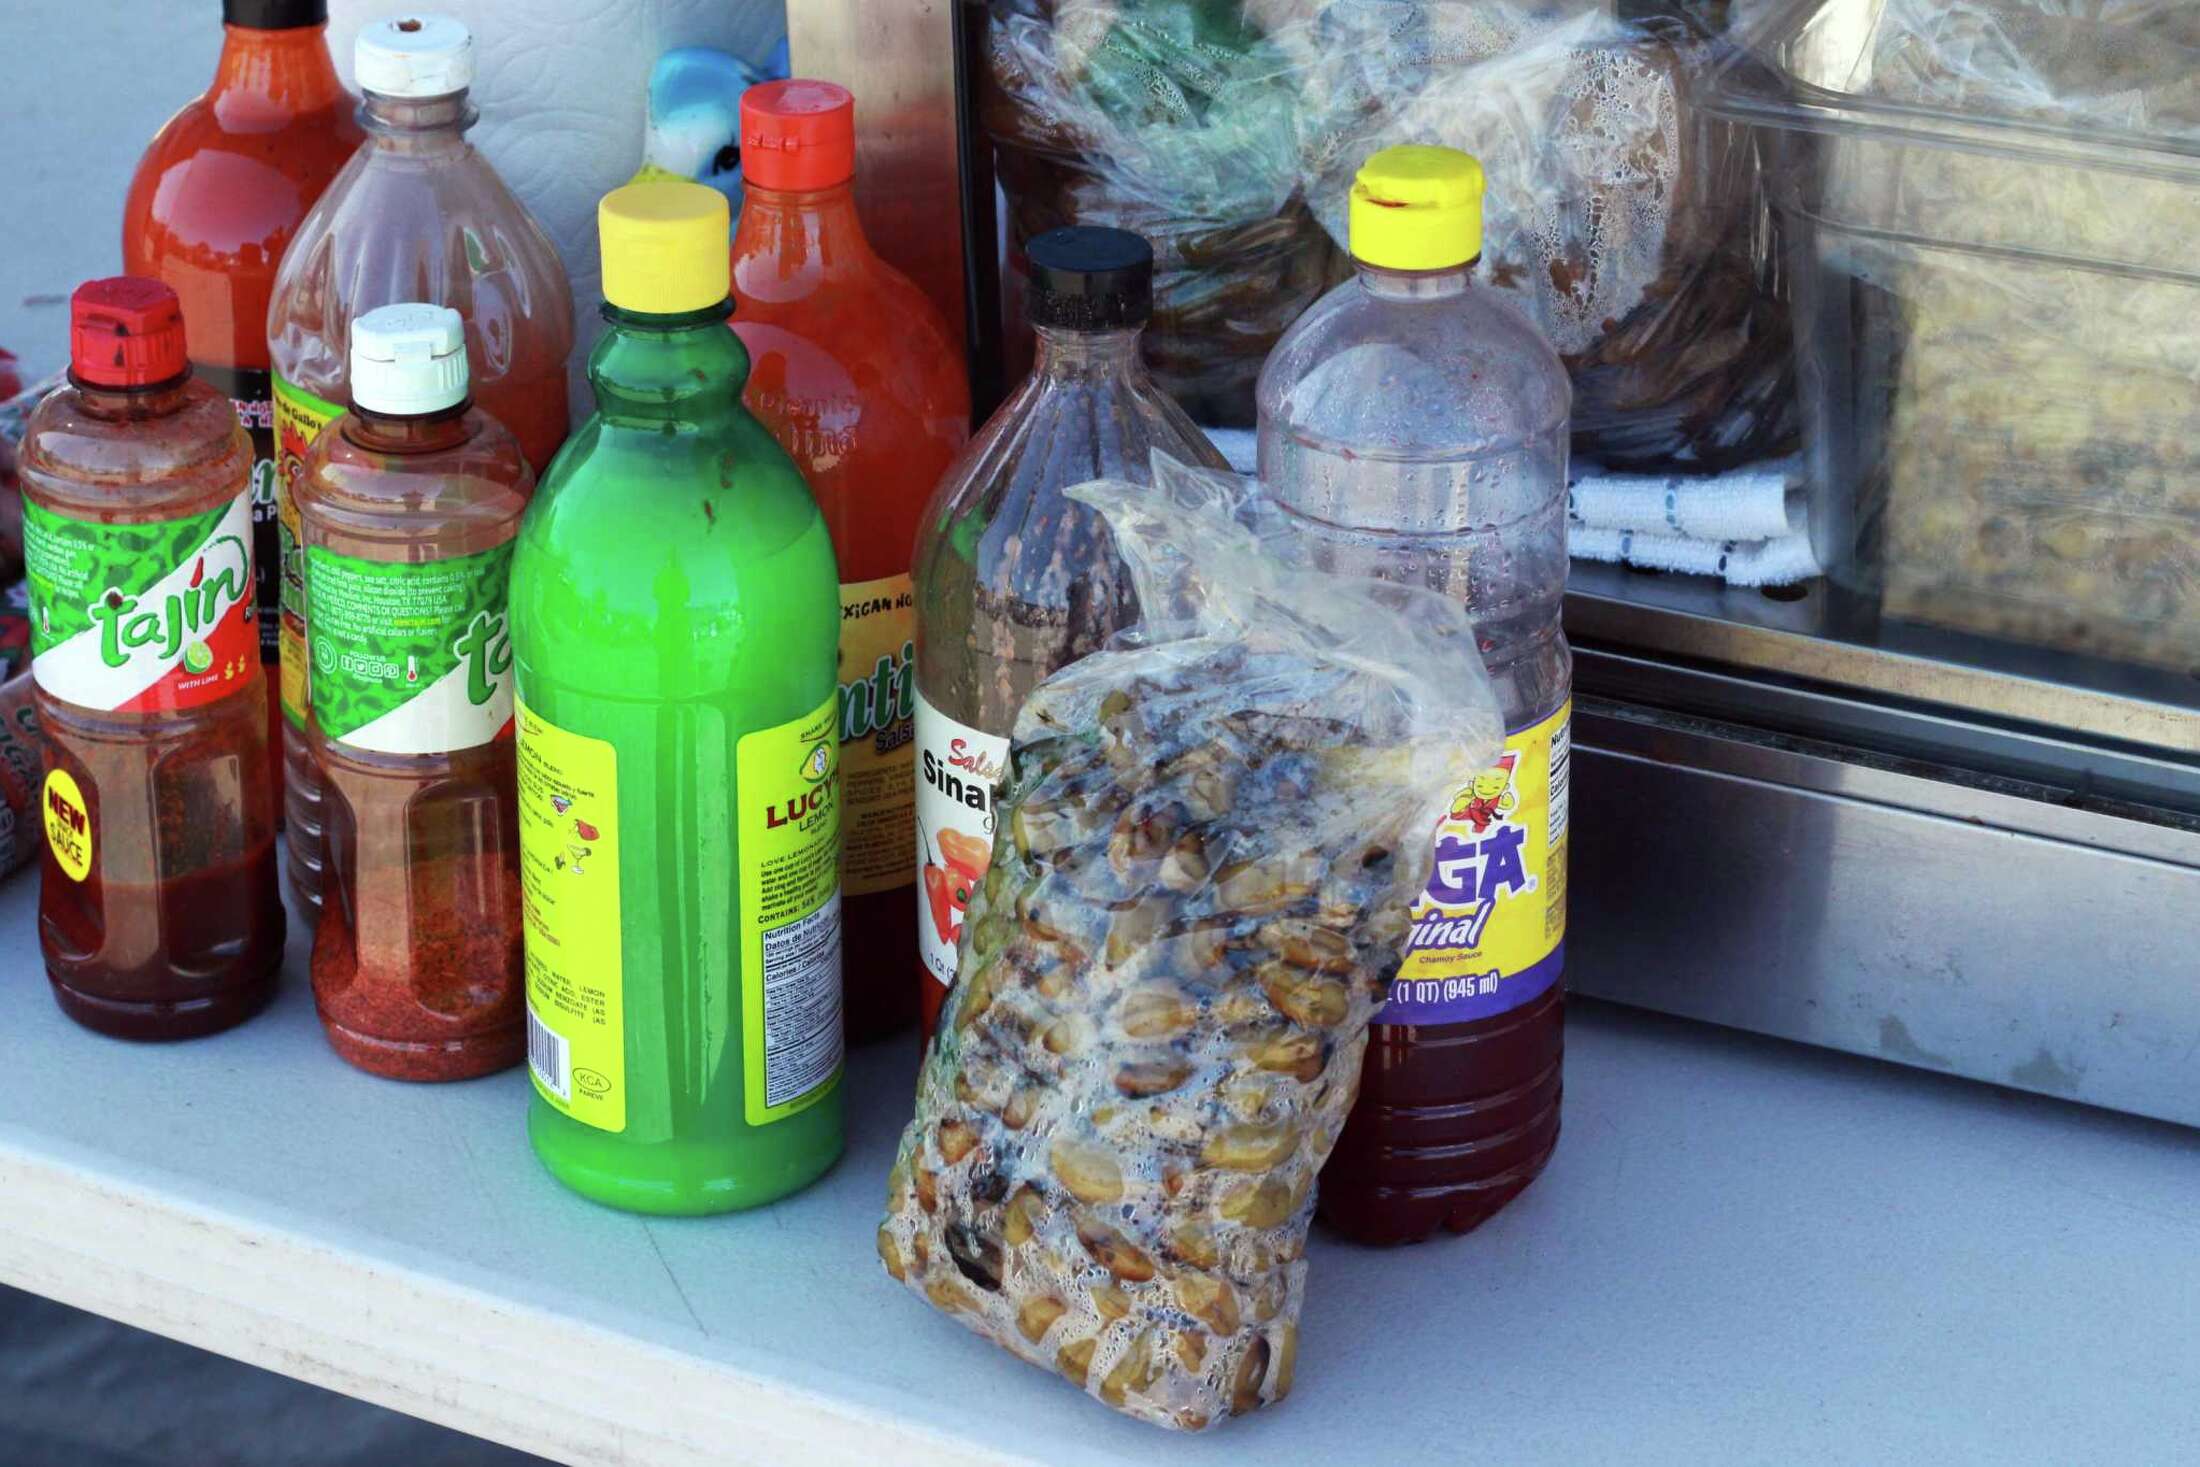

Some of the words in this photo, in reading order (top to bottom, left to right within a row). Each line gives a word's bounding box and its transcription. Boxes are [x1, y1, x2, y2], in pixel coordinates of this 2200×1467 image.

[291, 407, 317, 428] Gallo
[177, 680, 201, 690] WITH
[202, 674, 219, 685] LIME
[48, 785, 85, 836] NEW
[1409, 825, 1526, 907] GA
[765, 923, 800, 940] Nutrition
[765, 939, 790, 952] Datos
[1419, 954, 1456, 965] Chamoy
[1457, 950, 1483, 962] Sauce
[766, 967, 797, 981] Calories
[1416, 980, 1440, 1004] QT)
[1443, 975, 1476, 1003] (945
[1479, 970, 1499, 996] ml)
